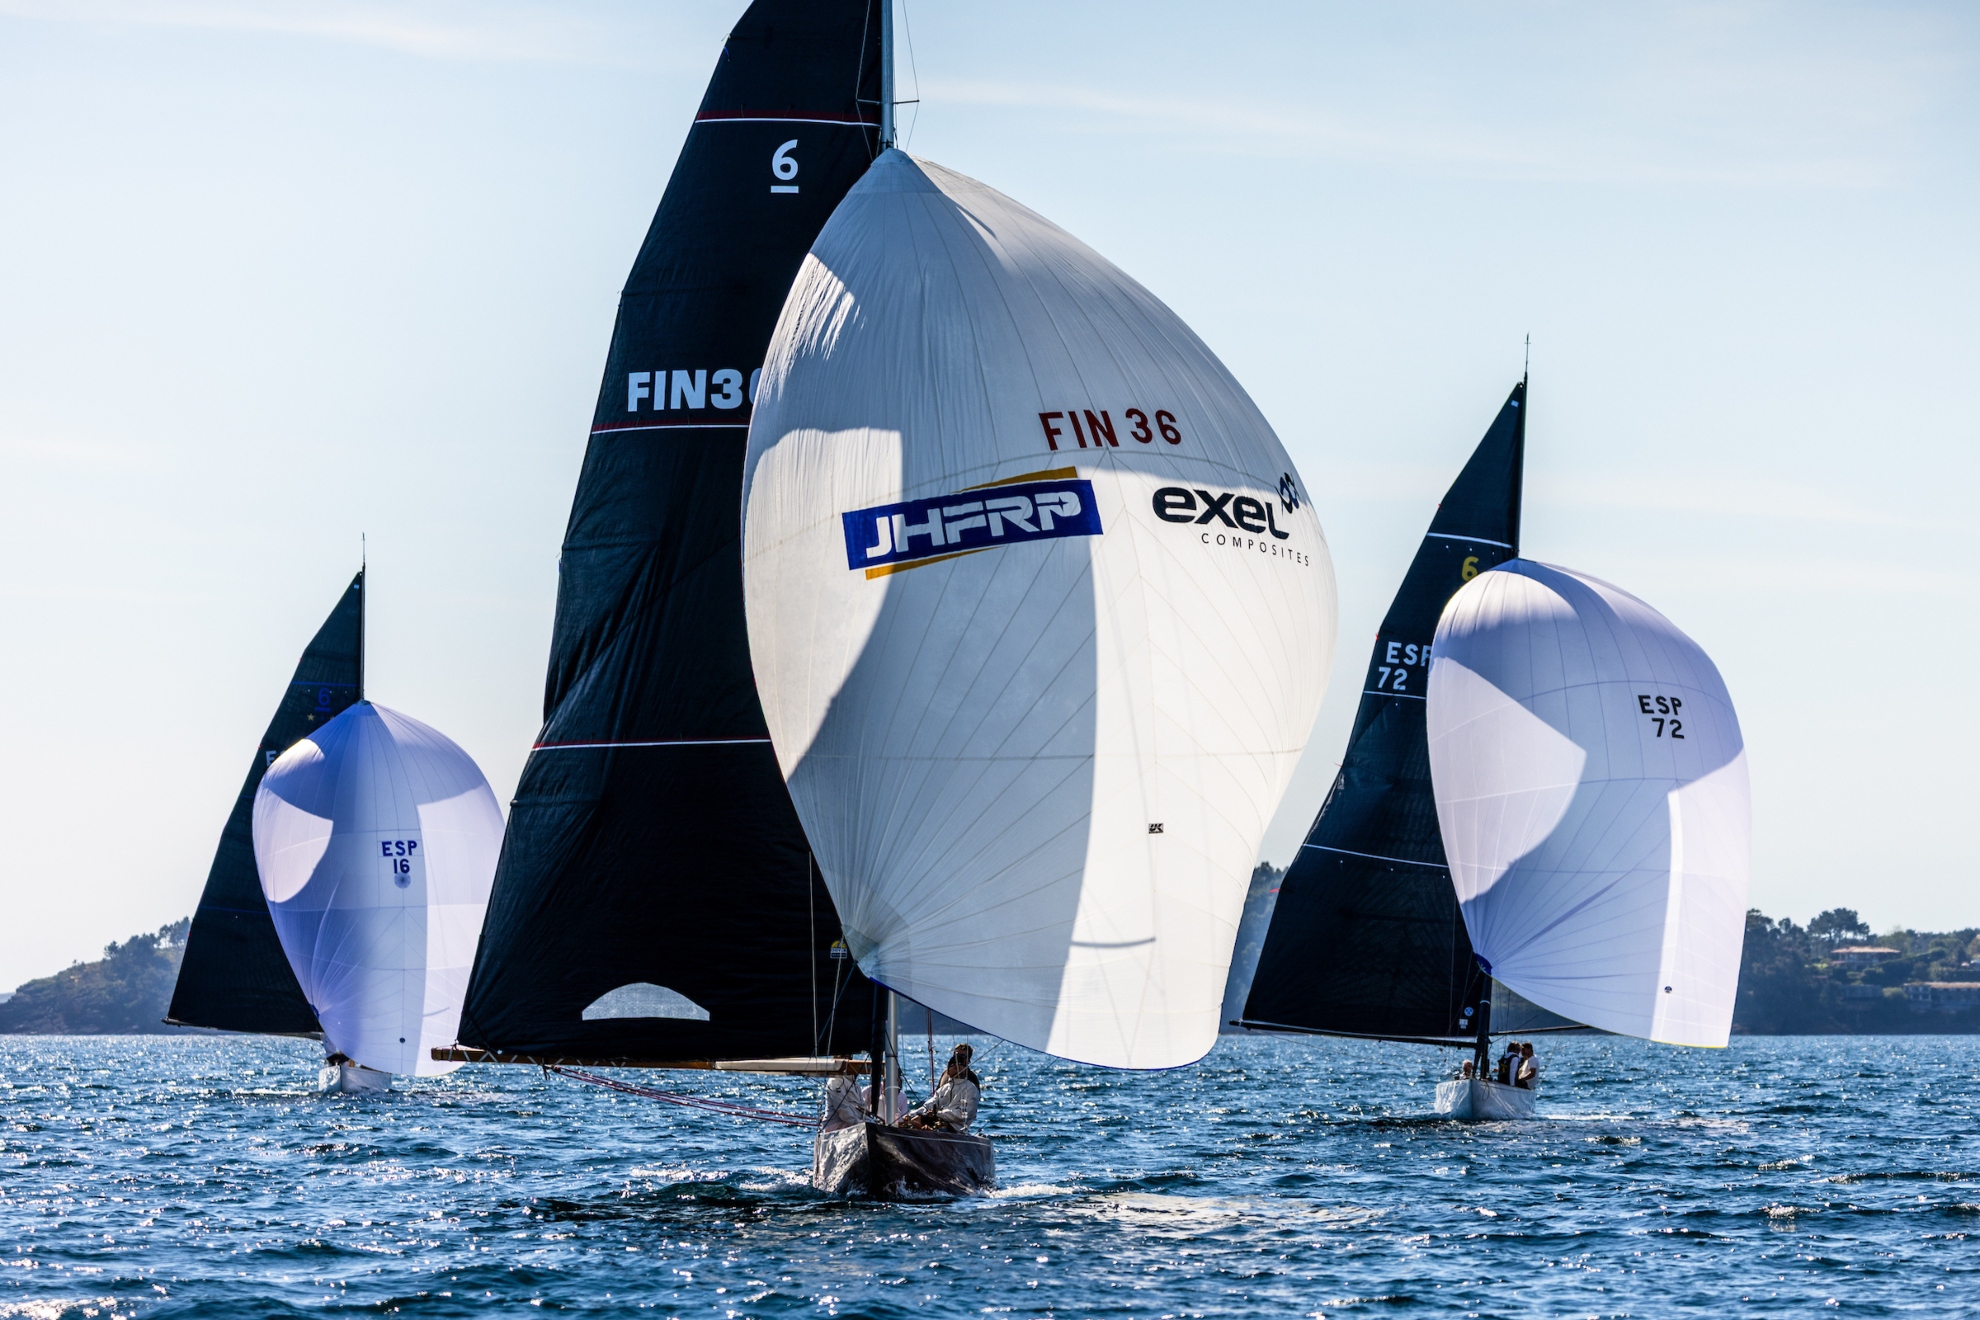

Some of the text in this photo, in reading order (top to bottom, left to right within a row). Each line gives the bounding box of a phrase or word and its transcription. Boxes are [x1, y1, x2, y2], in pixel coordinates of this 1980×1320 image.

[771, 139, 798, 181] 6
[1038, 407, 1182, 452] FIN 36
[865, 491, 1082, 559] JHFRP
[1201, 532, 1310, 567] COMPOSITES
[1461, 555, 1479, 582] 6
[1378, 666, 1408, 691] 72
[317, 687, 331, 707] 6
[1637, 694, 1683, 716] ESP
[1651, 717, 1685, 740] 72
[381, 840, 418, 857] ESP
[393, 858, 410, 874] 16
